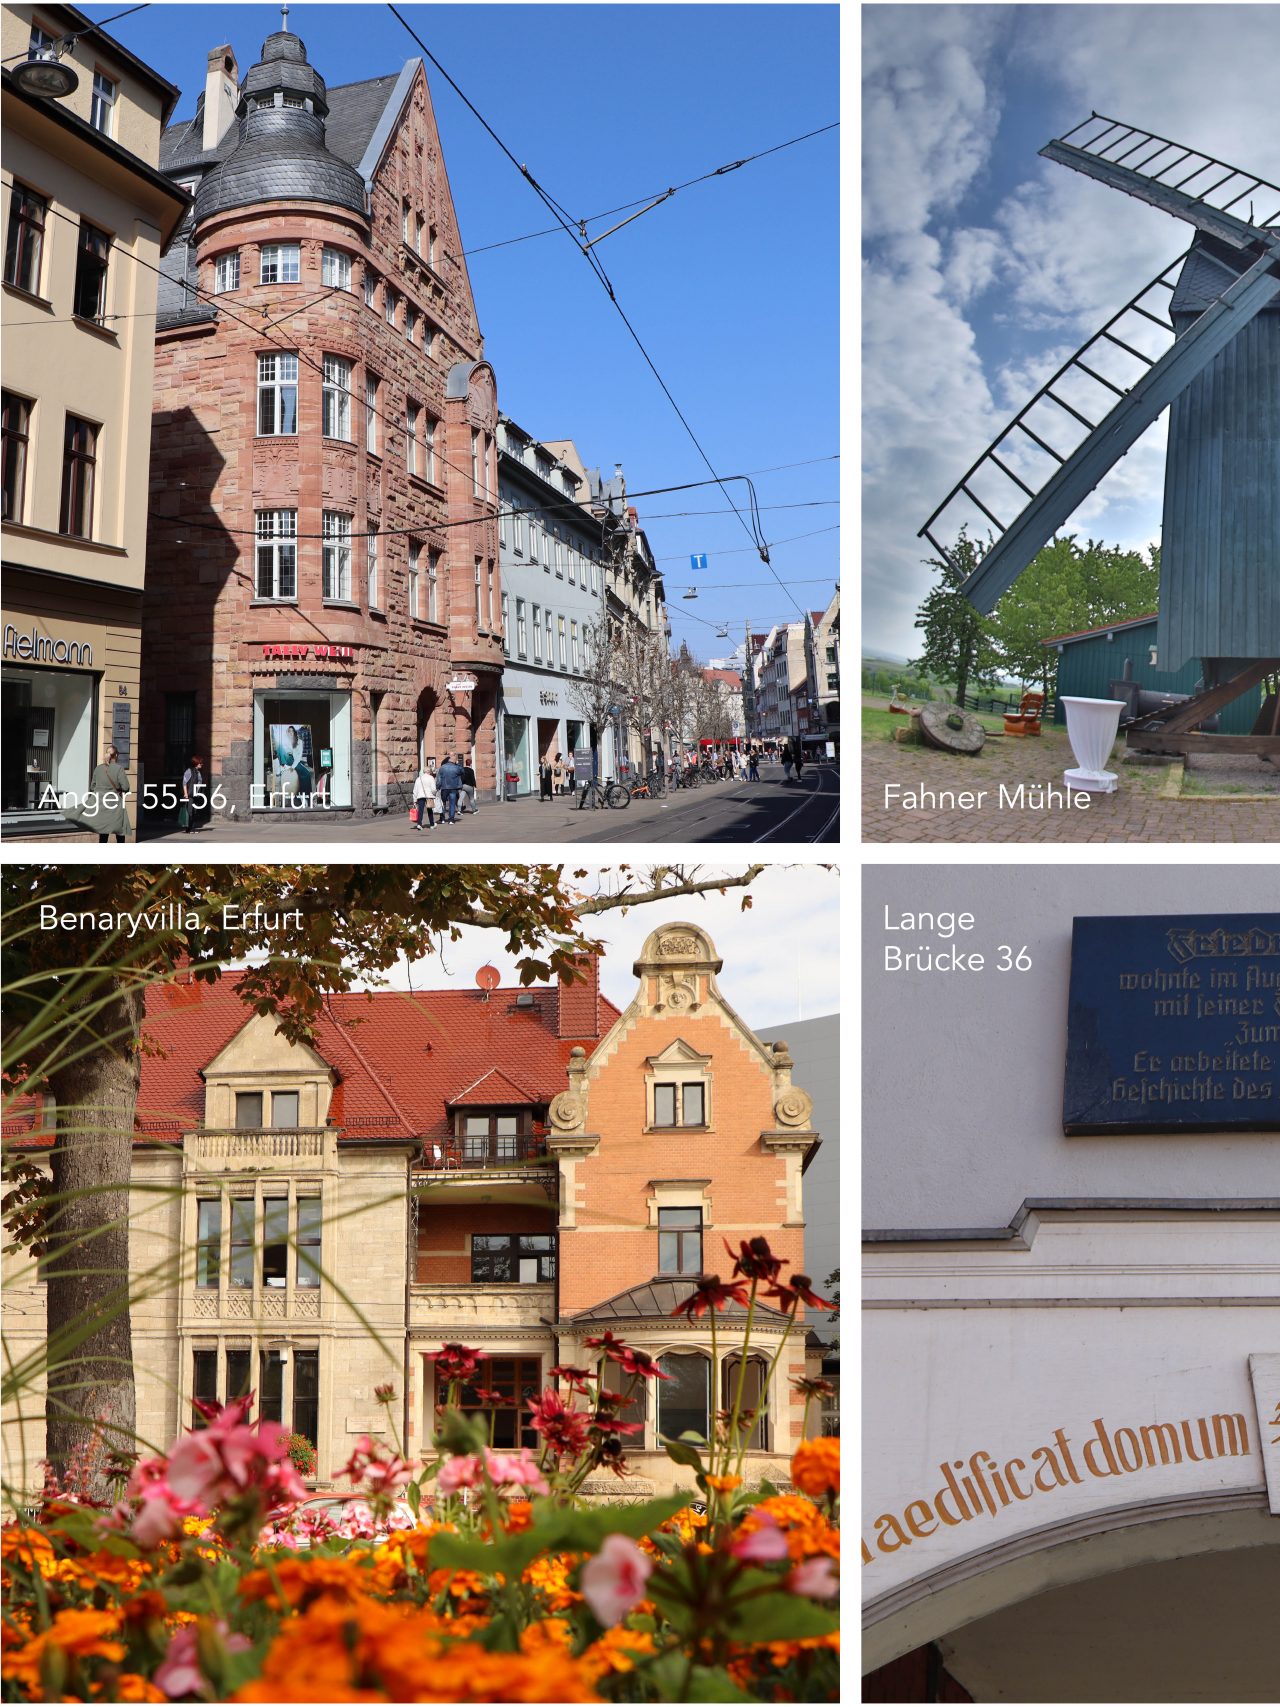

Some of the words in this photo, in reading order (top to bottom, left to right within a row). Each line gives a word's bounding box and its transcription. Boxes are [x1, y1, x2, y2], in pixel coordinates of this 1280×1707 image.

[262, 645, 309, 658] TALLY
[1119, 967, 1201, 991] wohnte
[1210, 968, 1239, 989] im
[1153, 993, 1190, 1017] mit
[1133, 1050, 1162, 1073] Er
[1232, 1077, 1273, 1101] des
[1082, 1412, 1253, 1478] domum
